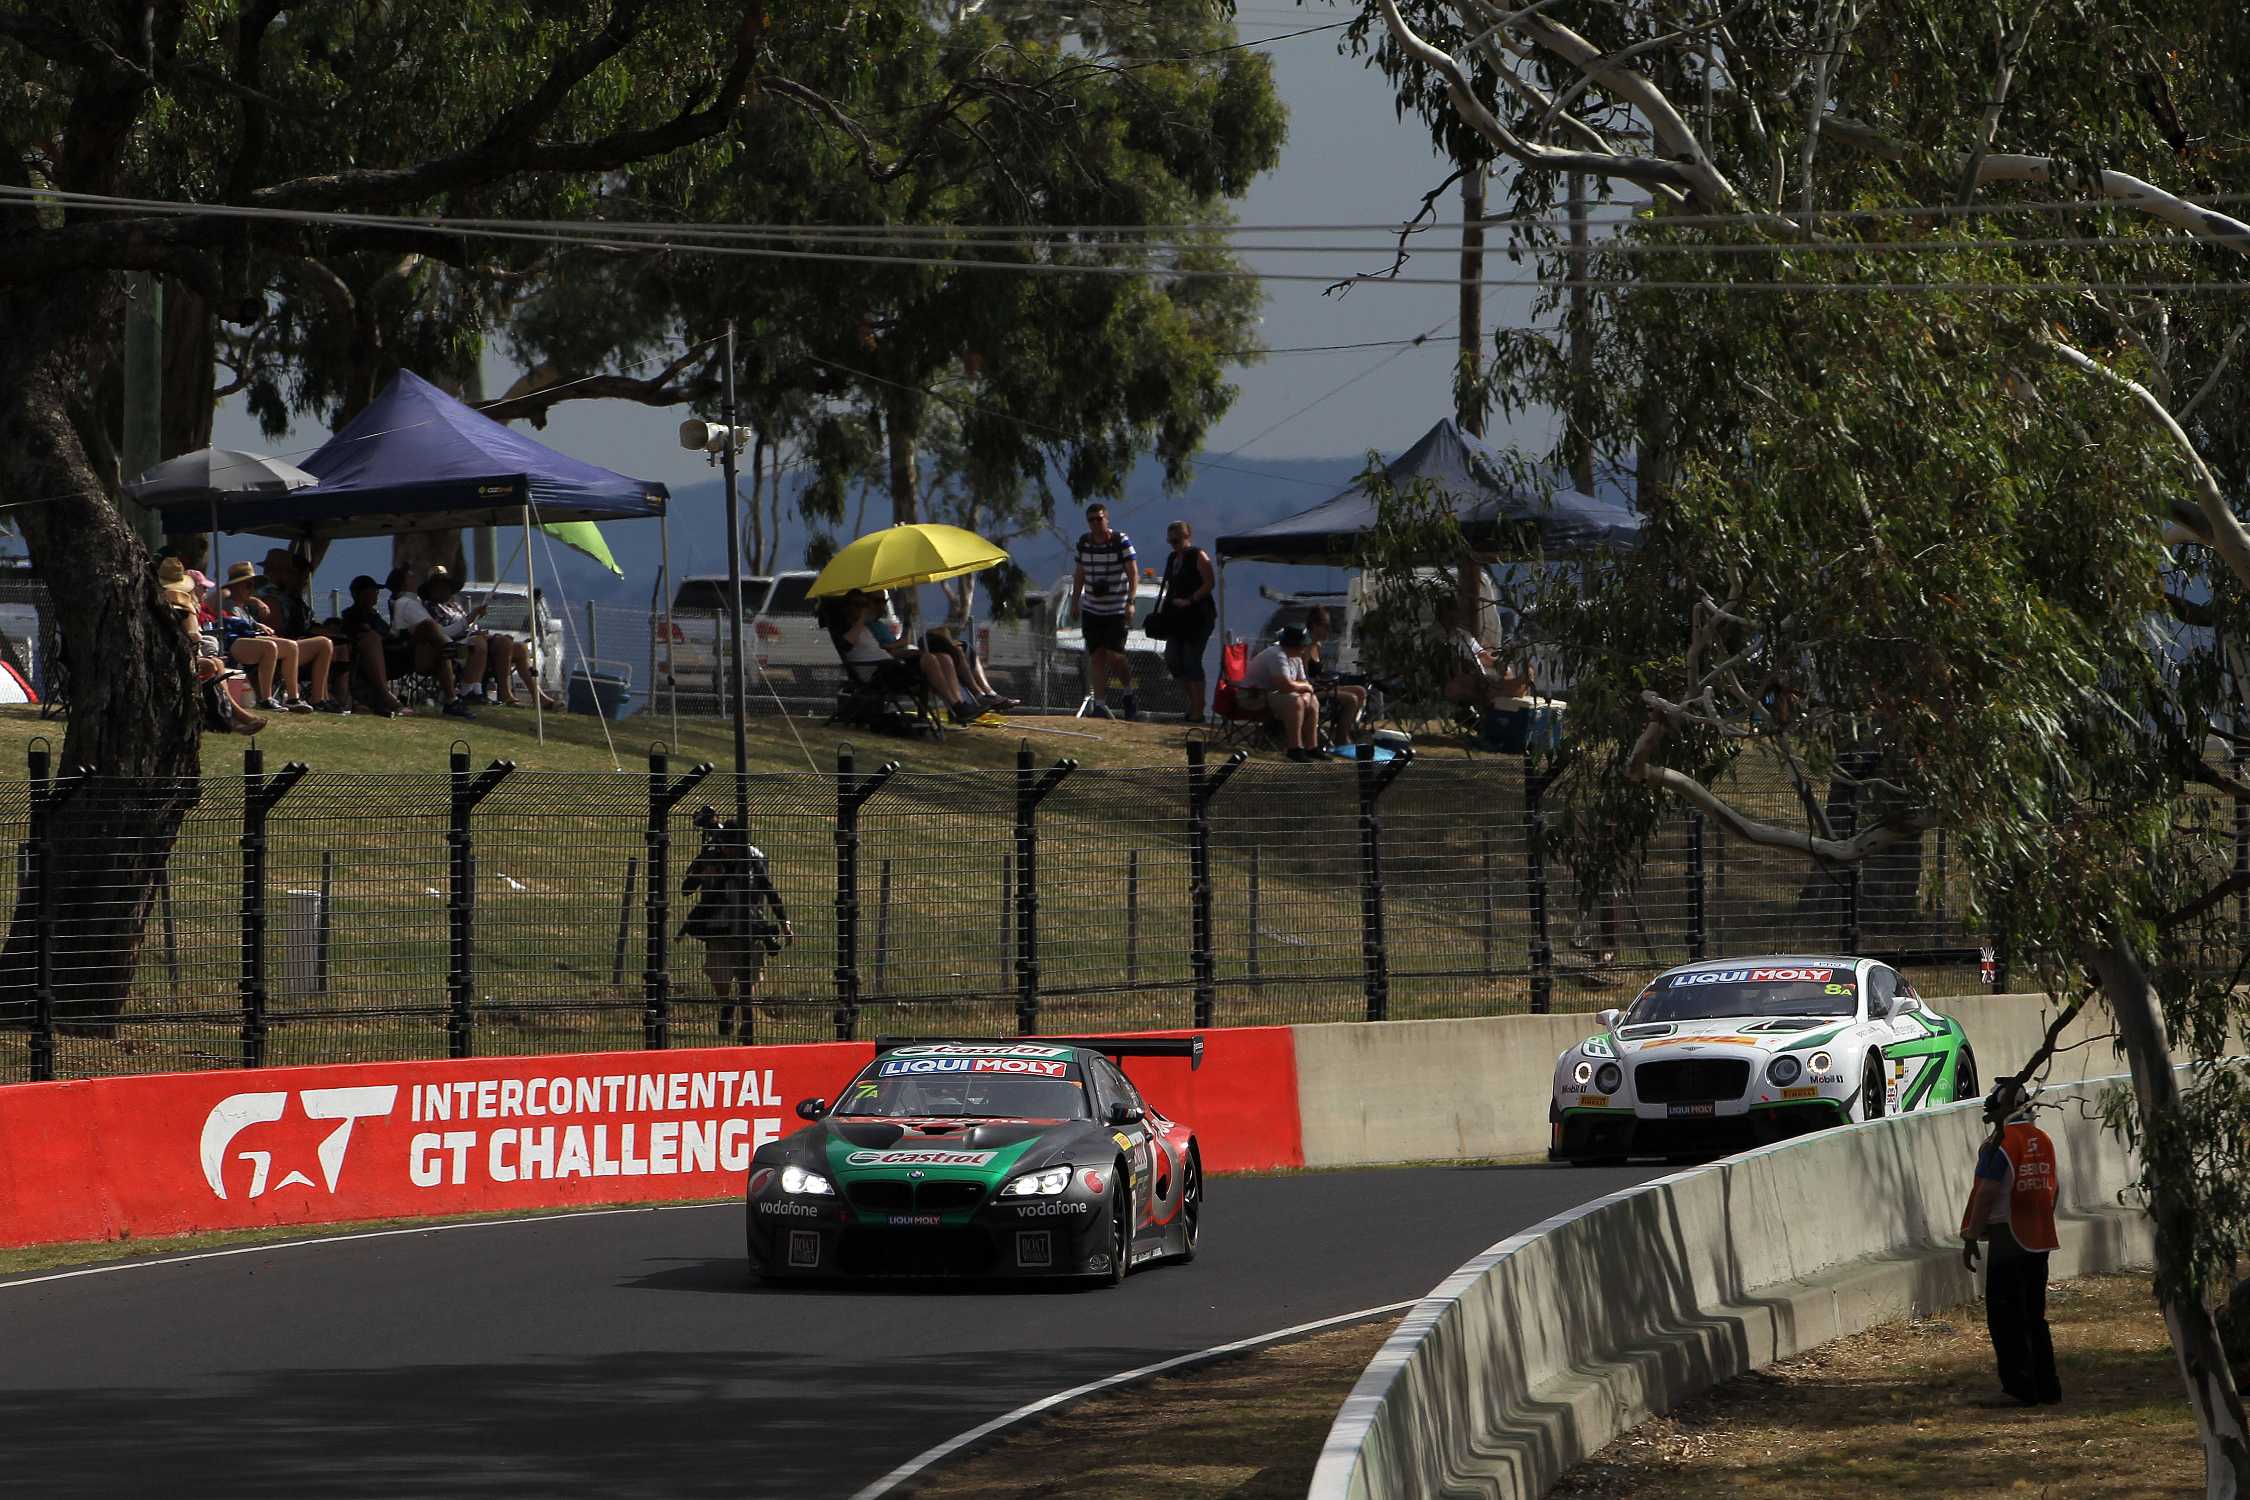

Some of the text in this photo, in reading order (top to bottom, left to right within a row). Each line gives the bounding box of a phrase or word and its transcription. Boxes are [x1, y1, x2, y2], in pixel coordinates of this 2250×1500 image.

[1675, 970, 1830, 986] LIQUI MOLY
[884, 1058, 1066, 1075] LIQUI MOLY
[1810, 1075, 1835, 1083] Mobil
[412, 1070, 782, 1122] INTERCONTINENTAL
[410, 1118, 781, 1187] GT CHALLENGE
[880, 1151, 988, 1165] Castrol
[760, 1200, 818, 1217] vodafone
[1017, 1200, 1087, 1217] vodafone
[889, 1216, 941, 1225] LIQUI MOLY
